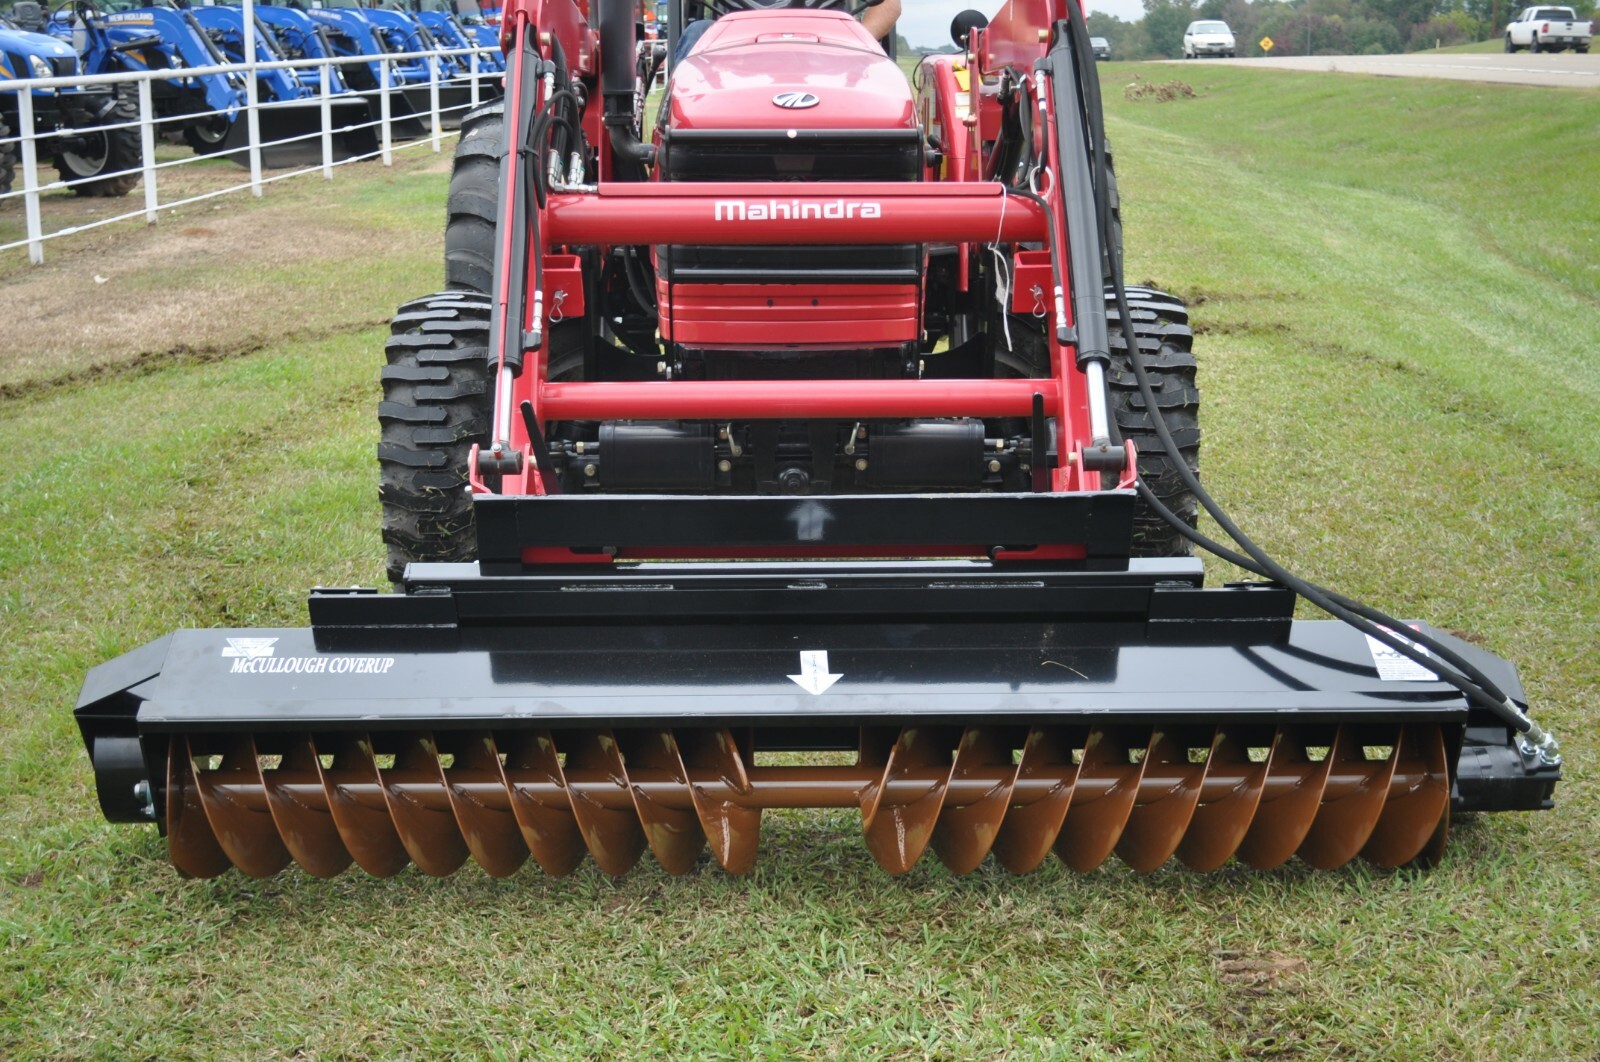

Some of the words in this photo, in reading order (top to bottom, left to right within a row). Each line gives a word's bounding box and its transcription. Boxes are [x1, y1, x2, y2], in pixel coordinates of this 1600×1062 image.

[108, 13, 123, 22] NEW
[124, 12, 154, 21] HOLLAND
[715, 200, 881, 221] Mahindra
[230, 657, 326, 673] McCULLOUGH
[328, 657, 395, 673] COVERUP
